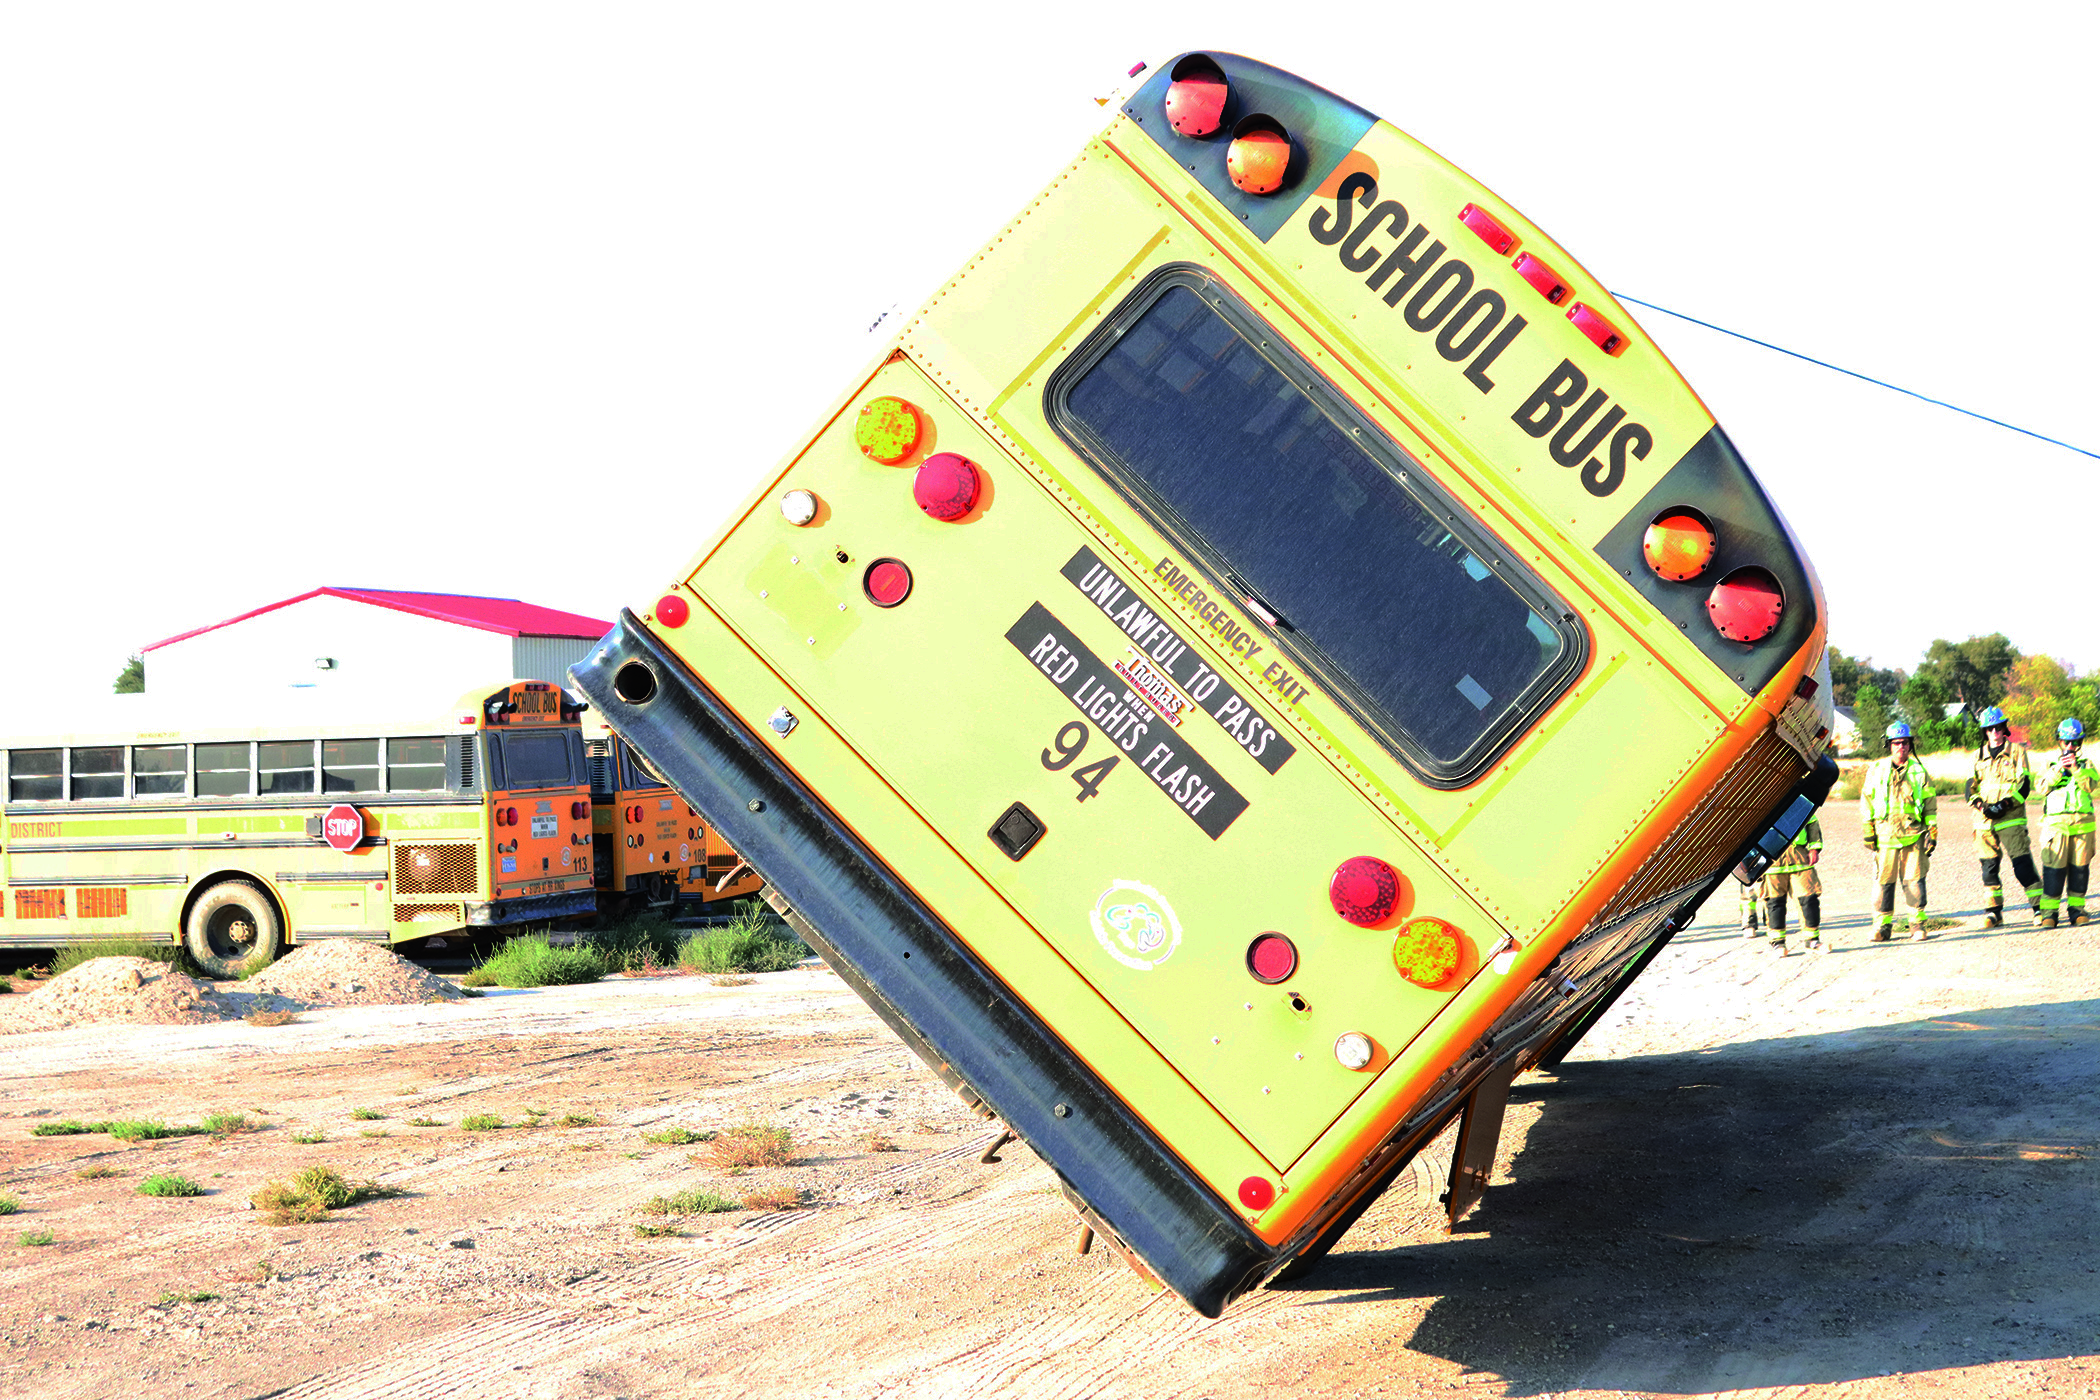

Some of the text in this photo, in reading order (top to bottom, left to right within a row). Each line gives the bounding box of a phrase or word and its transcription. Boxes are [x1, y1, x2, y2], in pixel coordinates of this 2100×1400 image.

[1308, 172, 1653, 498] SCHOOL BUS
[1153, 557, 1310, 706] EMERGENCY EXIT
[1079, 562, 1276, 757] UNLAWFUL TO PASS
[1126, 645, 1195, 713] Thomas
[513, 692, 557, 713] SCHOOL BUS
[1029, 633, 1216, 816] RED LIGHTS FLASH
[1122, 689, 1155, 722] WHEN
[1041, 721, 1121, 803] 94
[11, 822, 63, 838] DISTRICT
[327, 819, 357, 836] STOP
[573, 856, 587, 872] 113
[693, 848, 706, 862] 108
